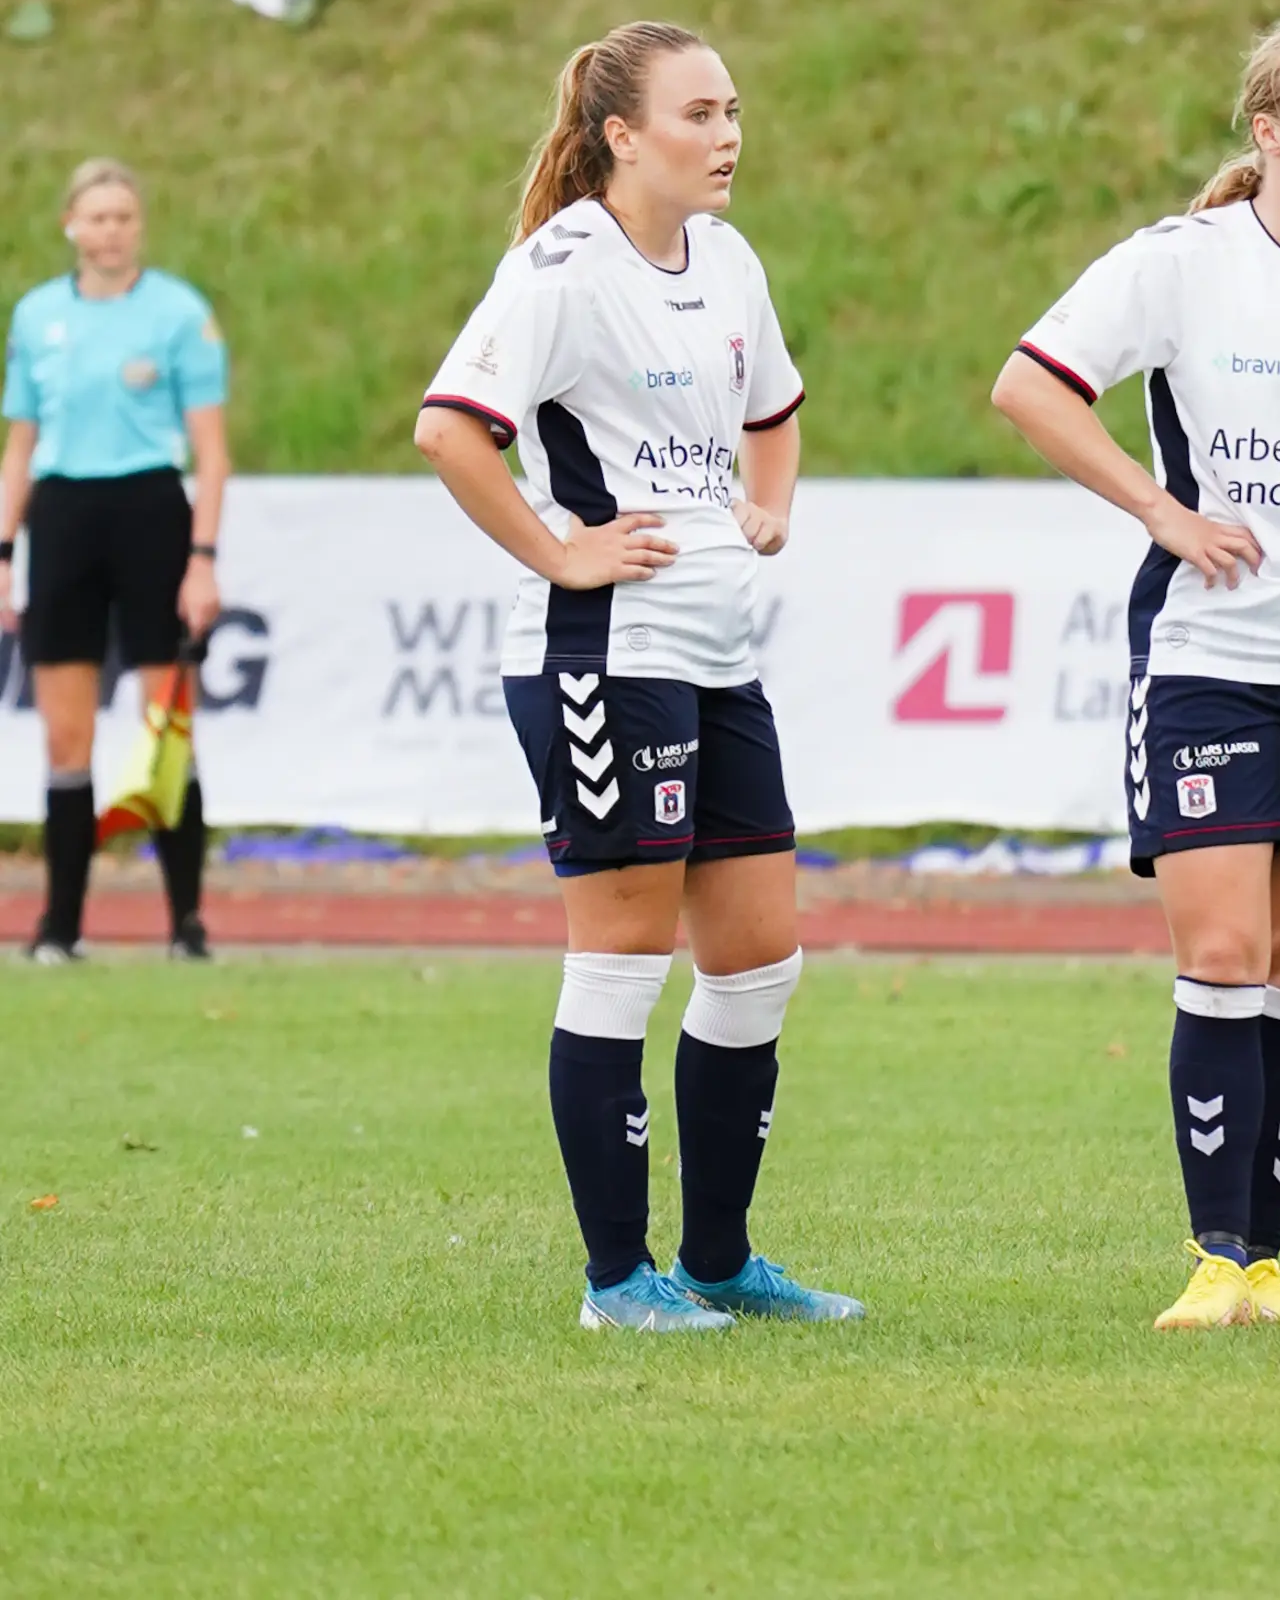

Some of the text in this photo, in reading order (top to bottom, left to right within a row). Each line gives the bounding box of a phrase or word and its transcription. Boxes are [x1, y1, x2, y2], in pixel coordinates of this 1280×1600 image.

[656, 743, 682, 758] LARS
[1194, 741, 1260, 757] LARS LARSEN
[657, 754, 688, 769] GROUP
[1195, 755, 1231, 768] GROUP
